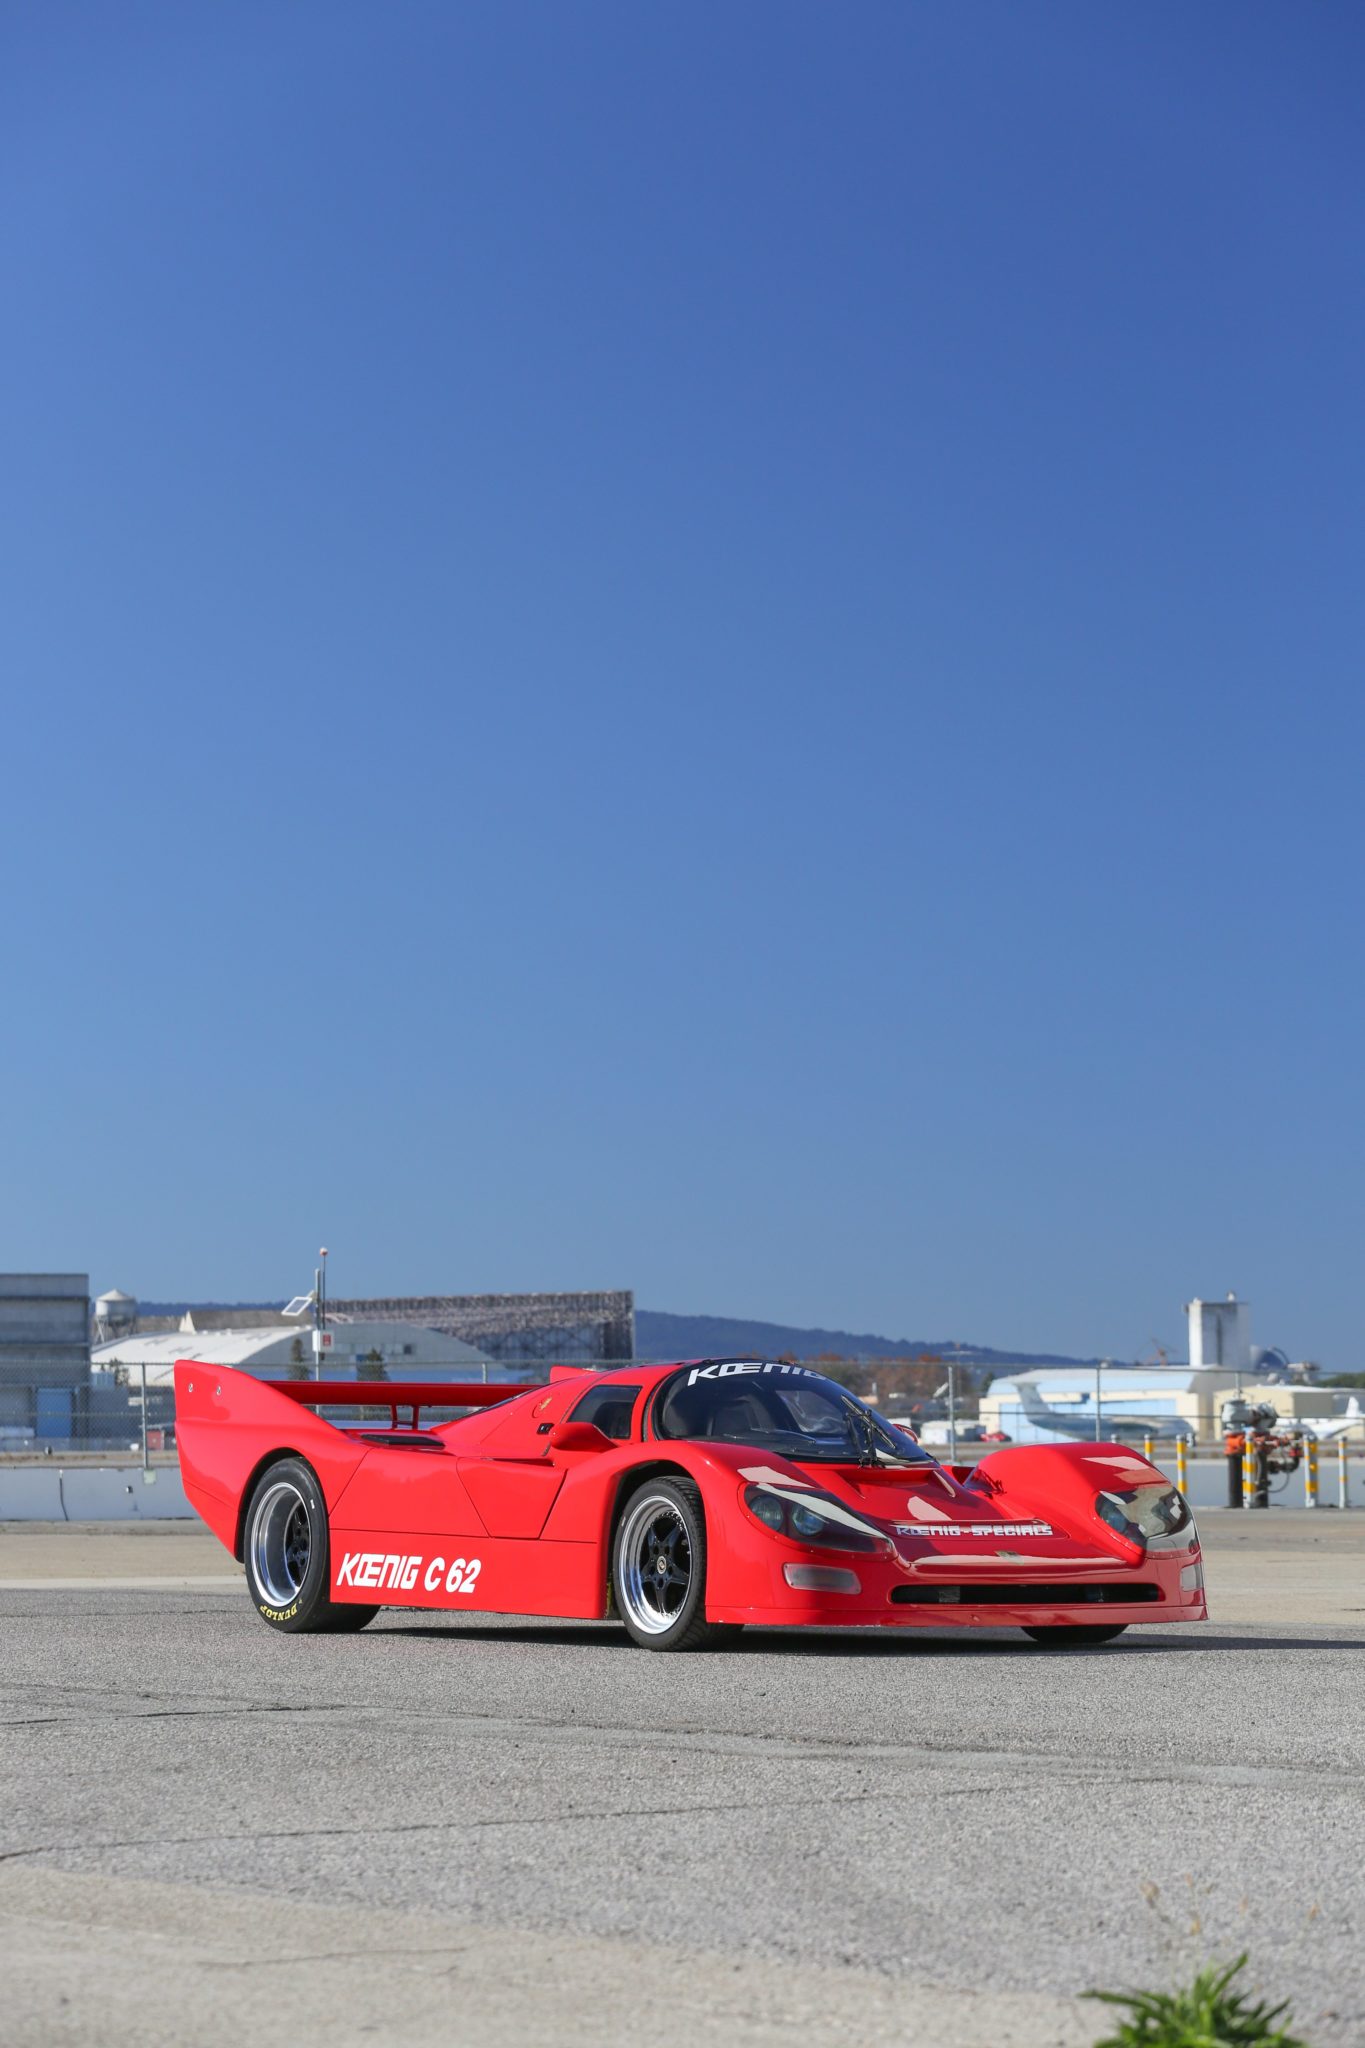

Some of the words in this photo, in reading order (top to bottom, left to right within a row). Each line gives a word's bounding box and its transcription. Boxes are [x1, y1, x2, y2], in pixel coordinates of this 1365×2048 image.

[424, 1557, 445, 1591] C
[446, 1558, 482, 1593] 62
[259, 1603, 298, 1621] DUNLOP
